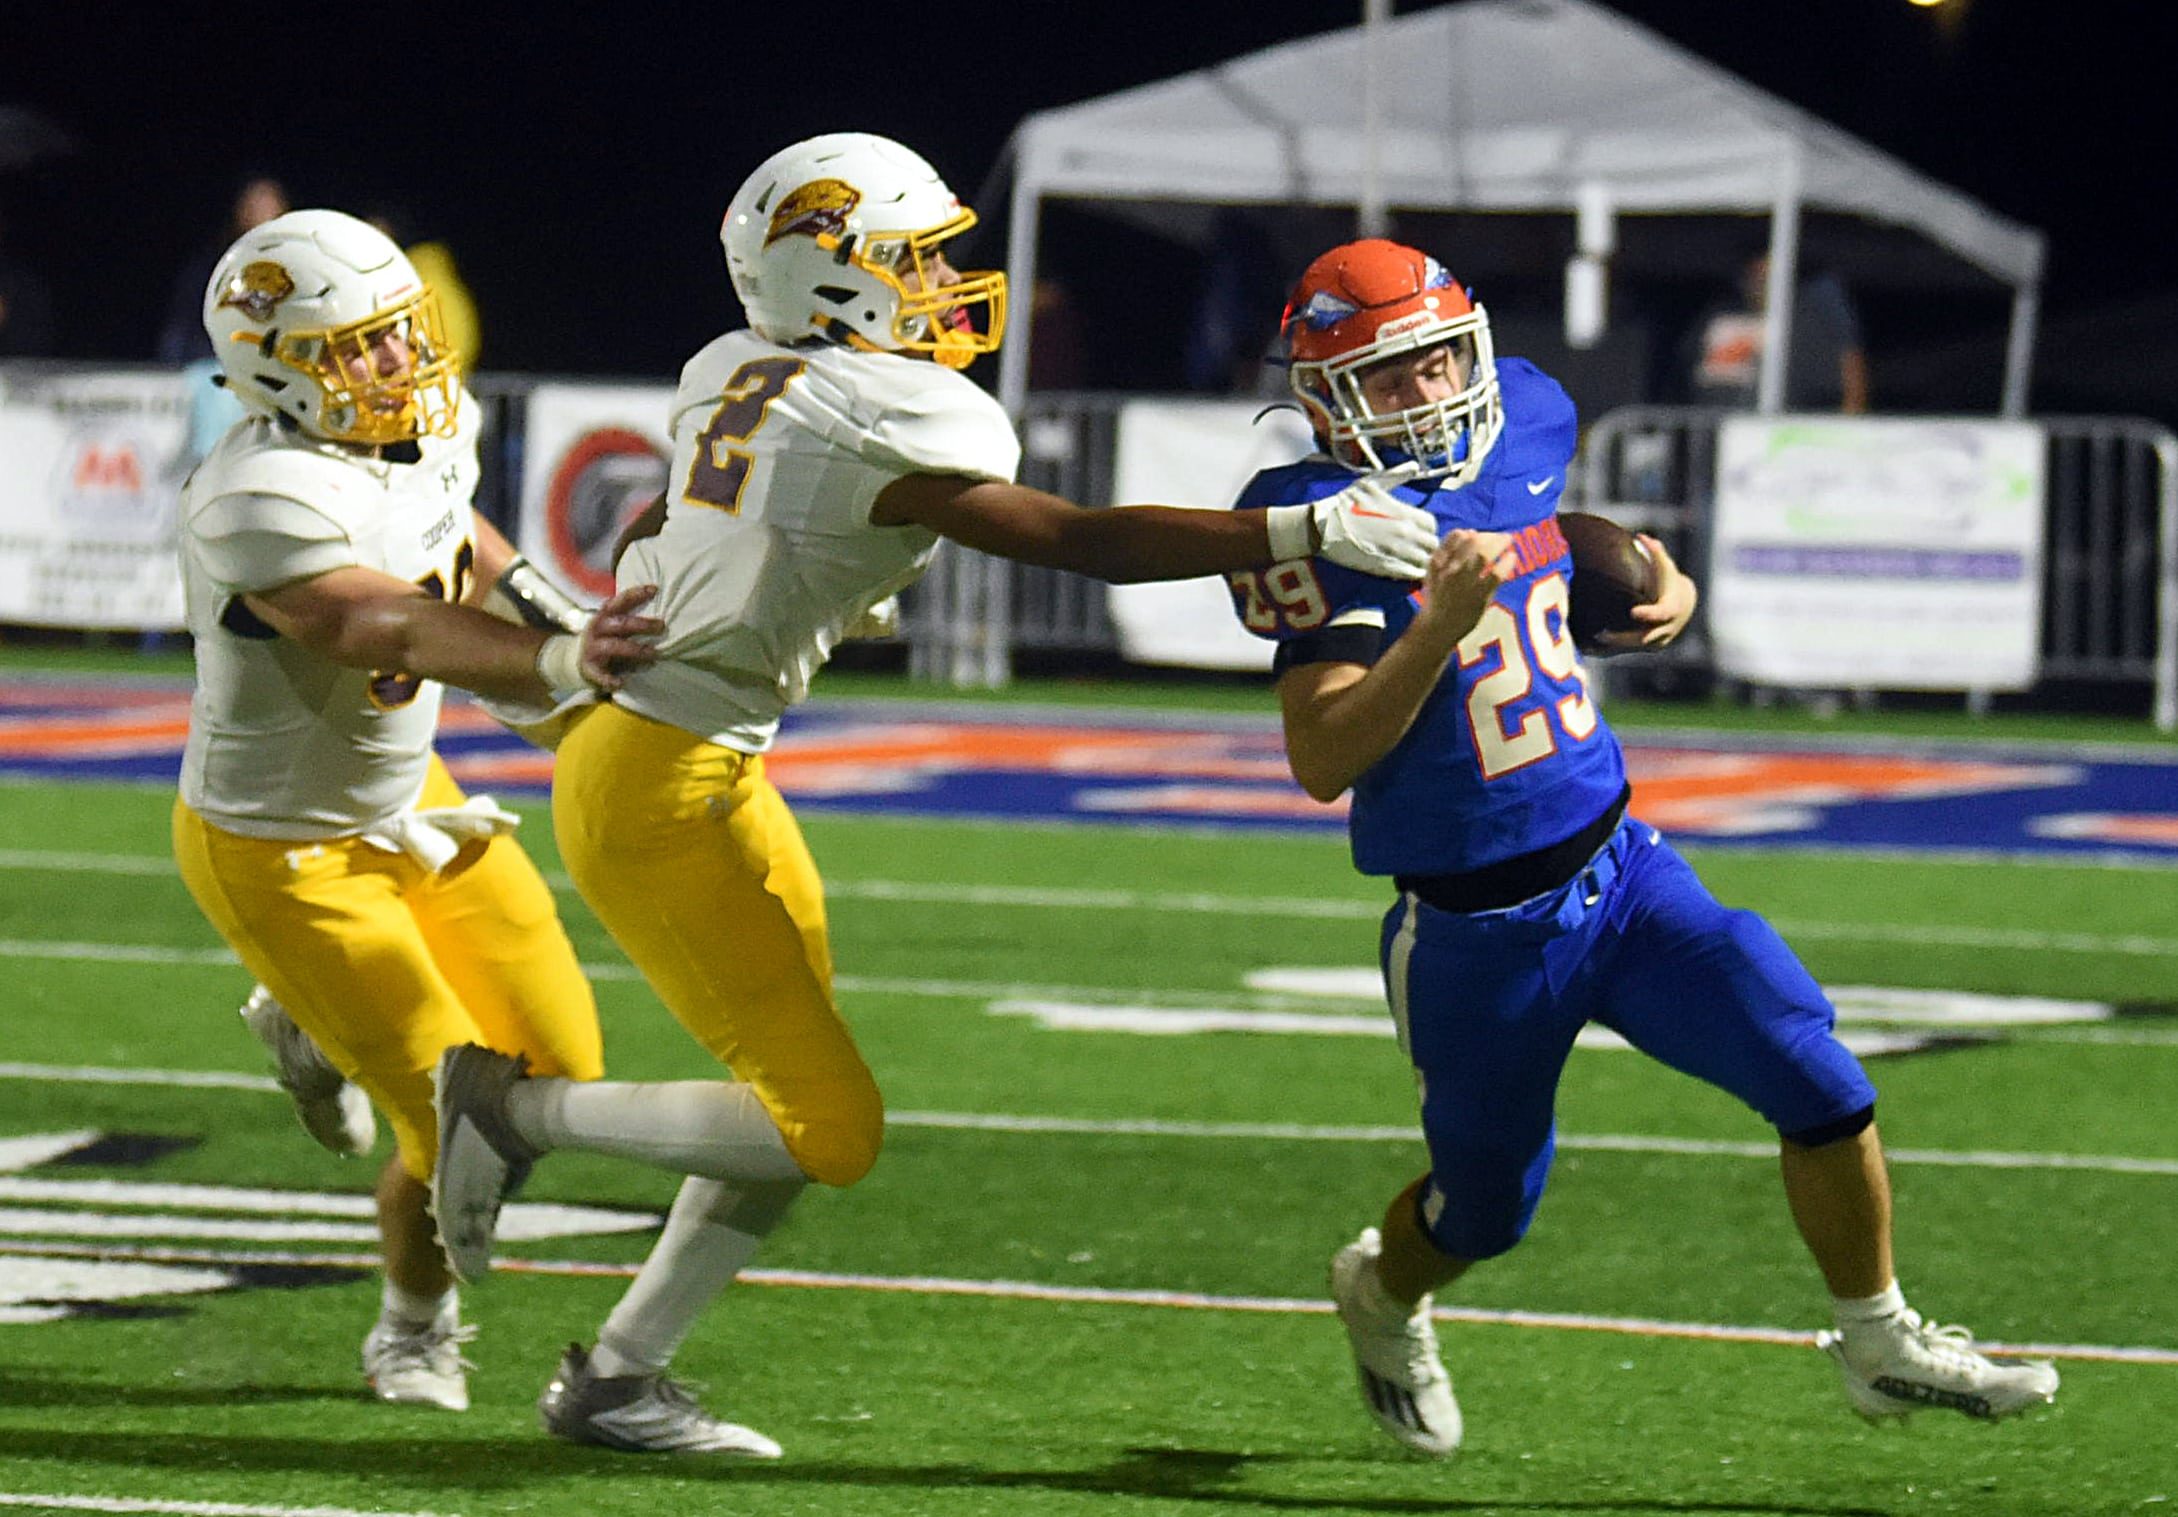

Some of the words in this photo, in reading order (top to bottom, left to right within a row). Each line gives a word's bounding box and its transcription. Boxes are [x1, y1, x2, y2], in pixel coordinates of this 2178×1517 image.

[683, 356, 807, 517] 2
[1229, 558, 1331, 632] 29
[1456, 571, 1597, 782] 29
